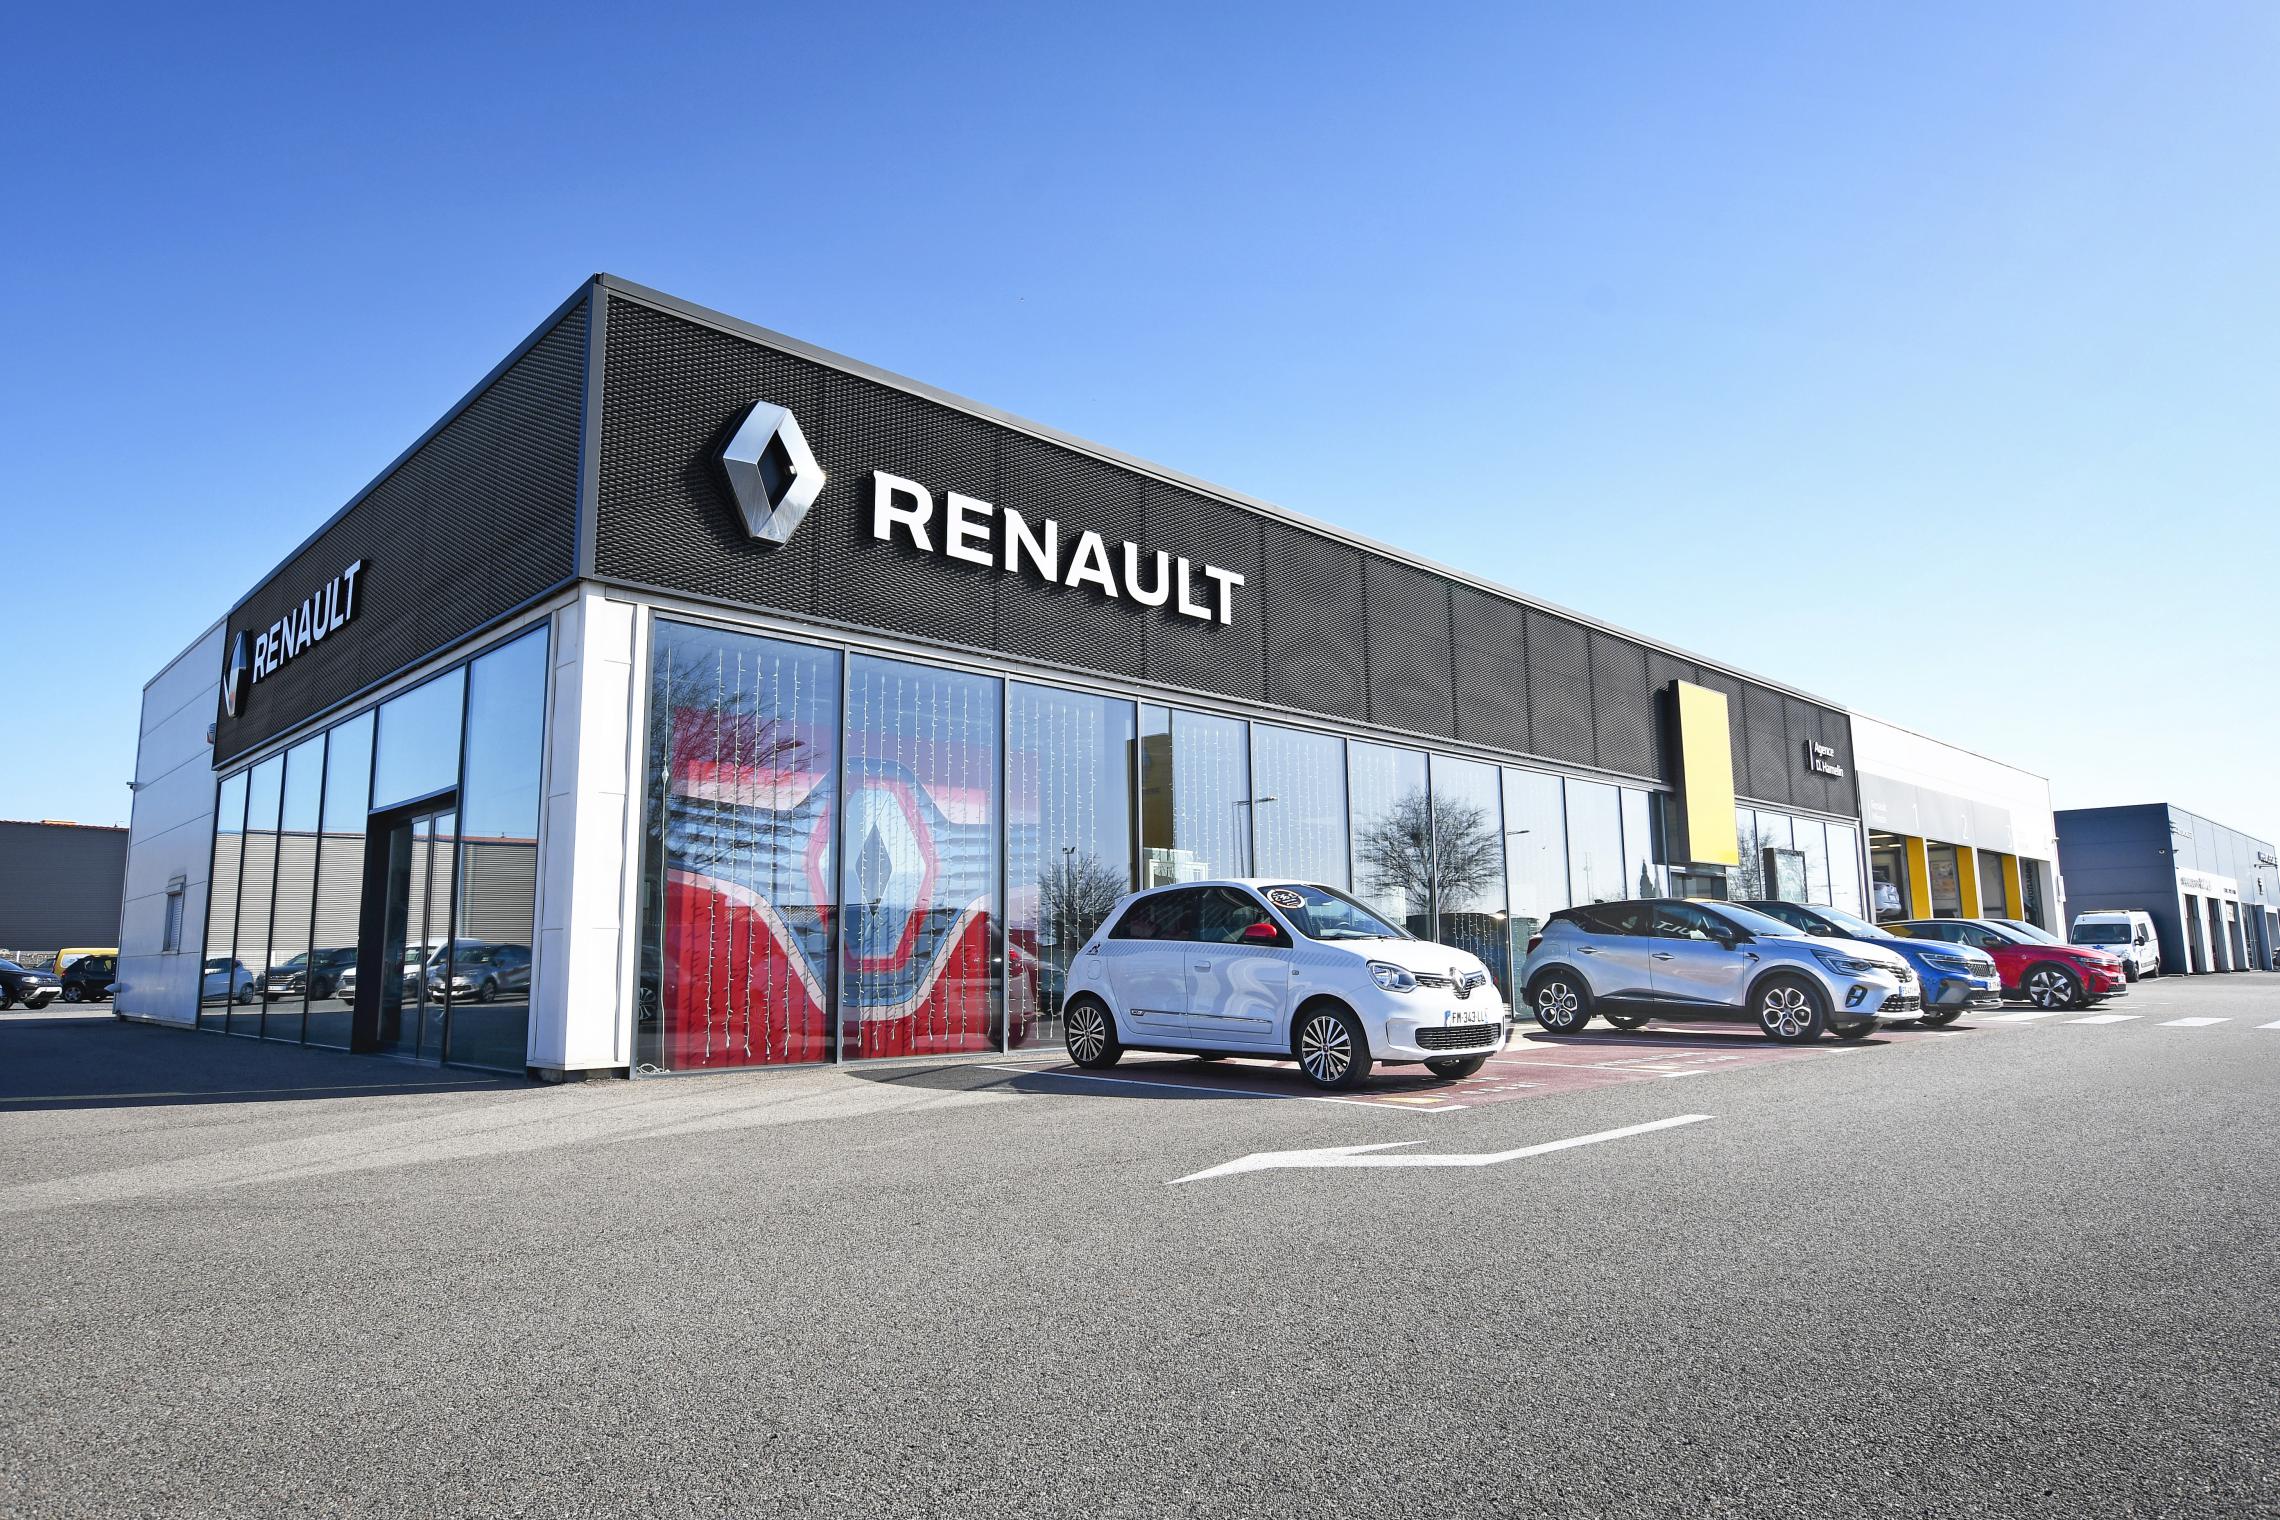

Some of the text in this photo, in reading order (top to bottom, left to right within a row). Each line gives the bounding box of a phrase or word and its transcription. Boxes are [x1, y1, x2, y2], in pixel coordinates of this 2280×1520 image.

[873, 470, 1245, 626] RENAULT
[252, 559, 361, 684] RENAULT
[1814, 741, 1835, 757] Agence
